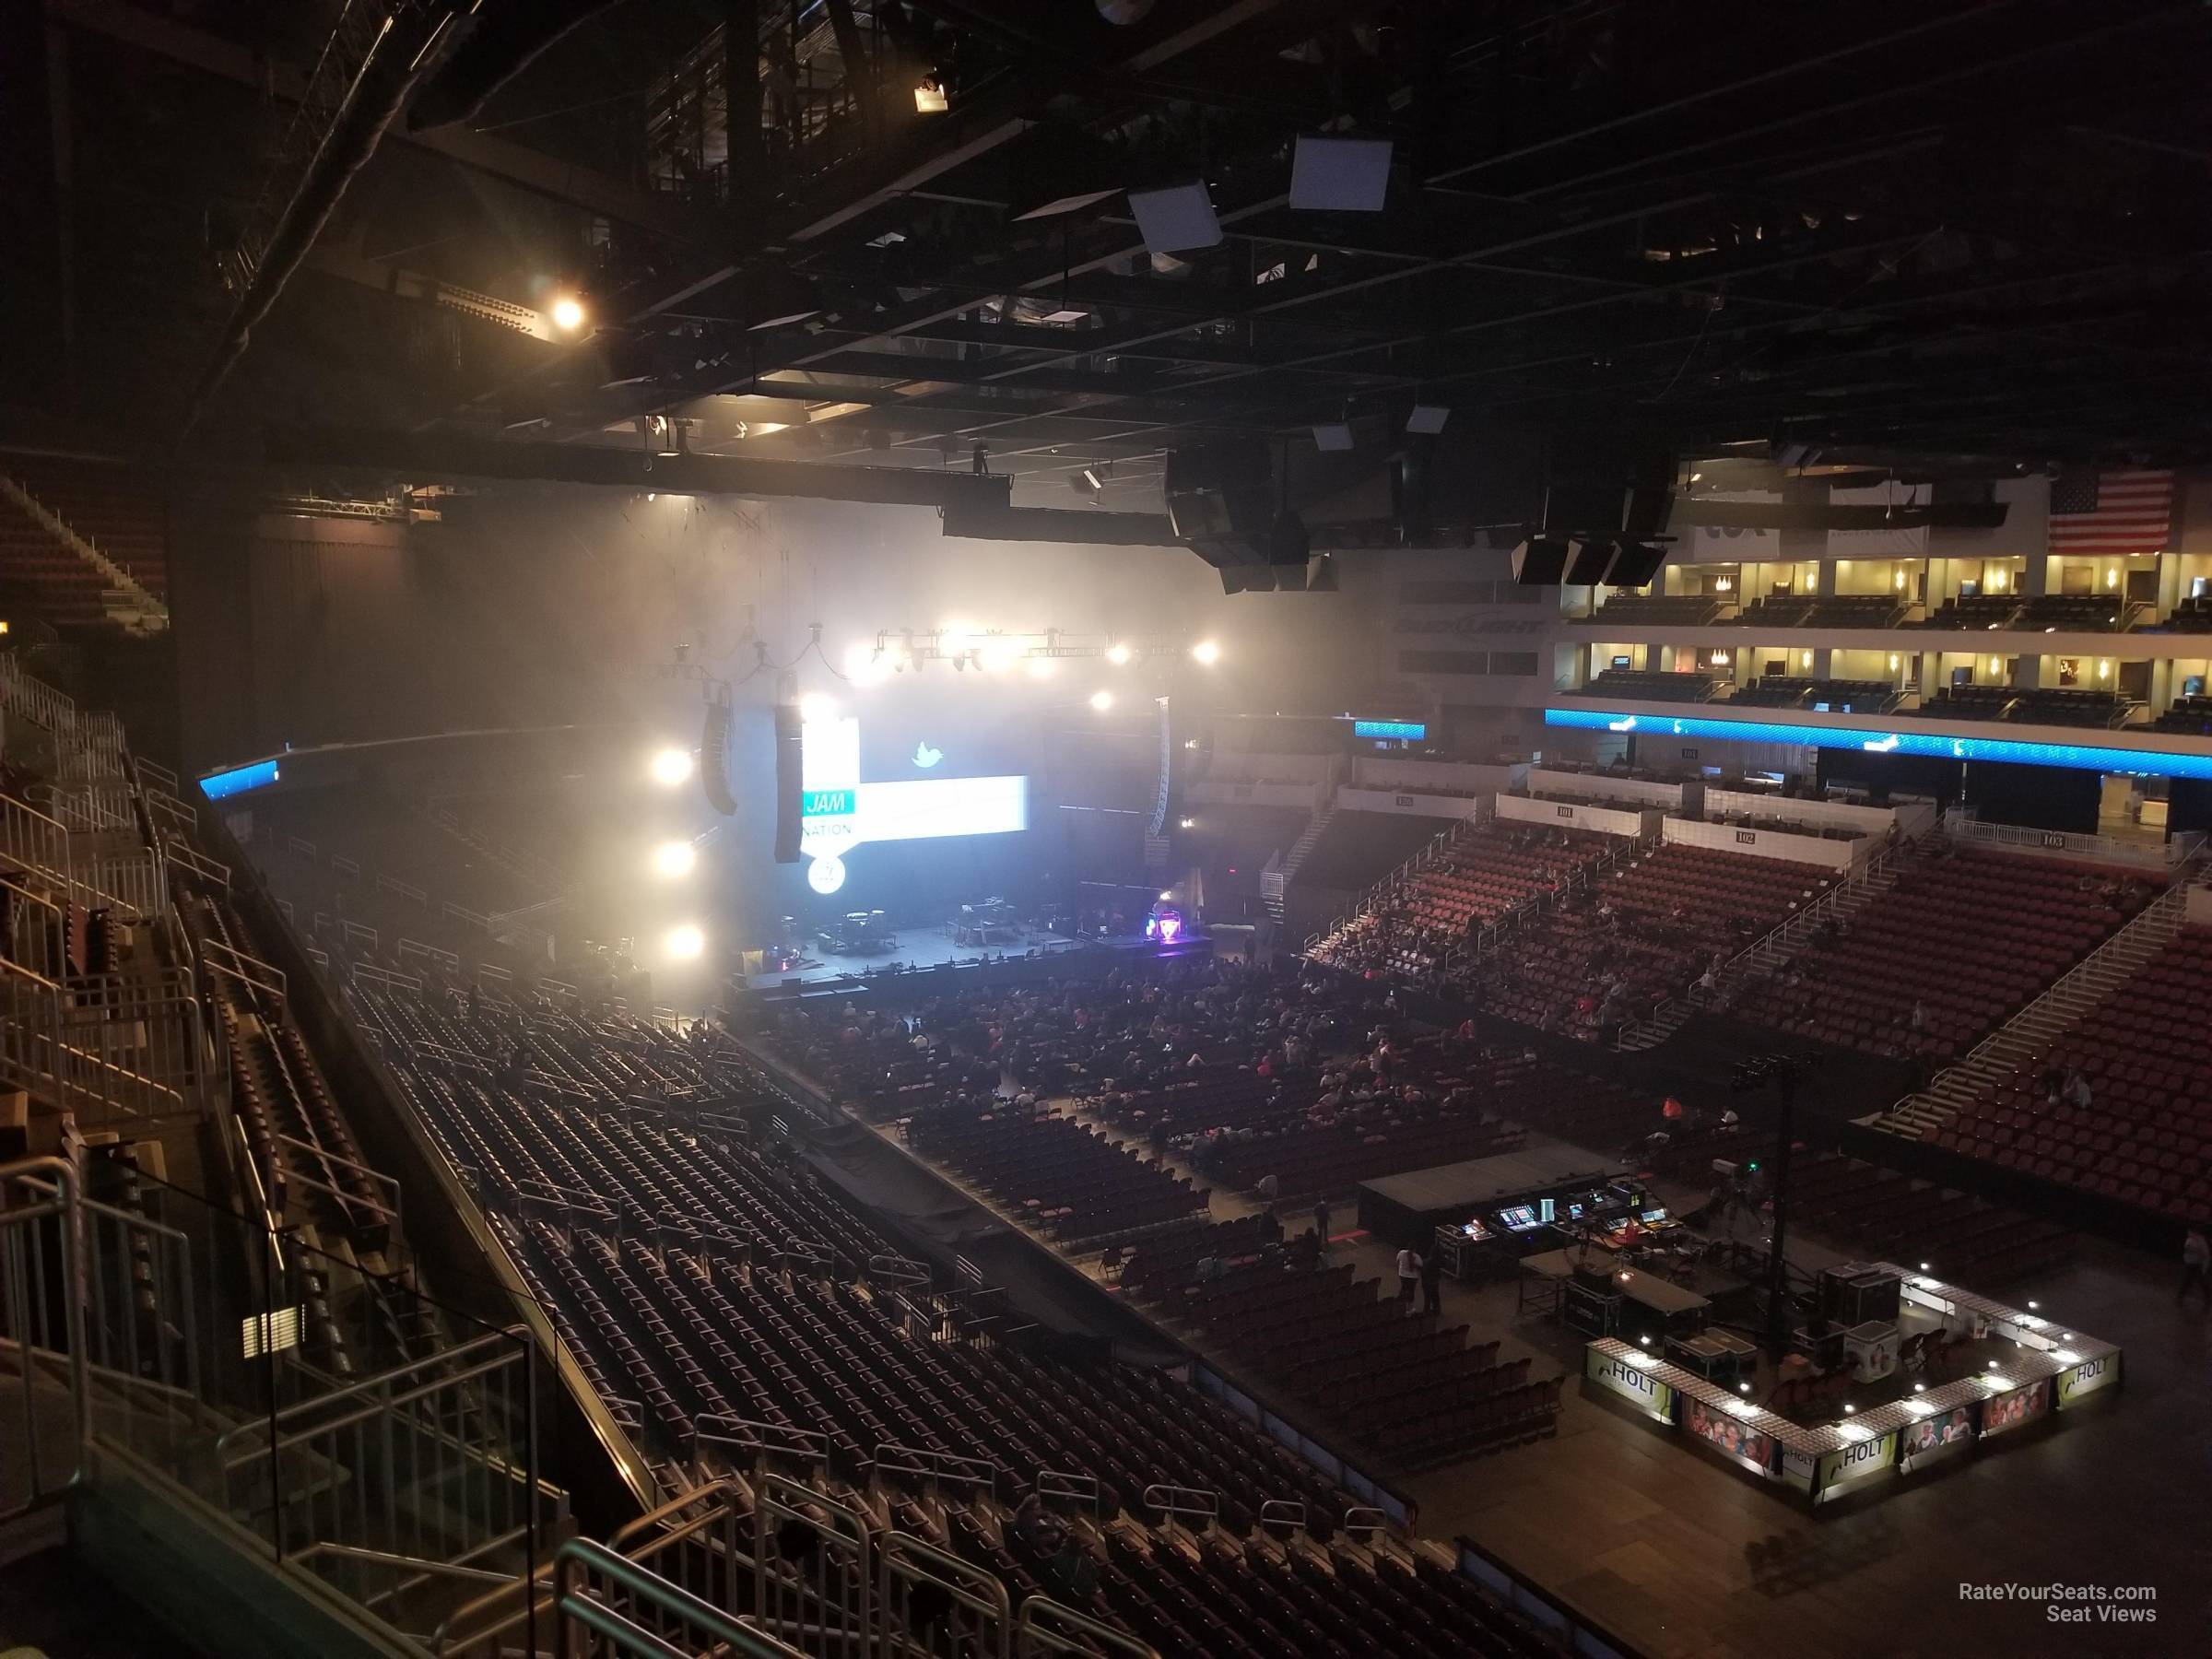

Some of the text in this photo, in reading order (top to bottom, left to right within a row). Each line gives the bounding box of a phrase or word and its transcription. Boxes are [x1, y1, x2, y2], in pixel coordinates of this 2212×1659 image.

[806, 793, 845, 813] JAM
[1559, 807, 1571, 818] 101
[1738, 832, 1754, 843] 102
[2043, 833, 2064, 848] 103
[1612, 1361, 1657, 1396] HOLT
[2077, 1357, 2109, 1382] HOLT
[1790, 1450, 1813, 1466] HOLT
[1844, 1438, 1885, 1467] HOLT
